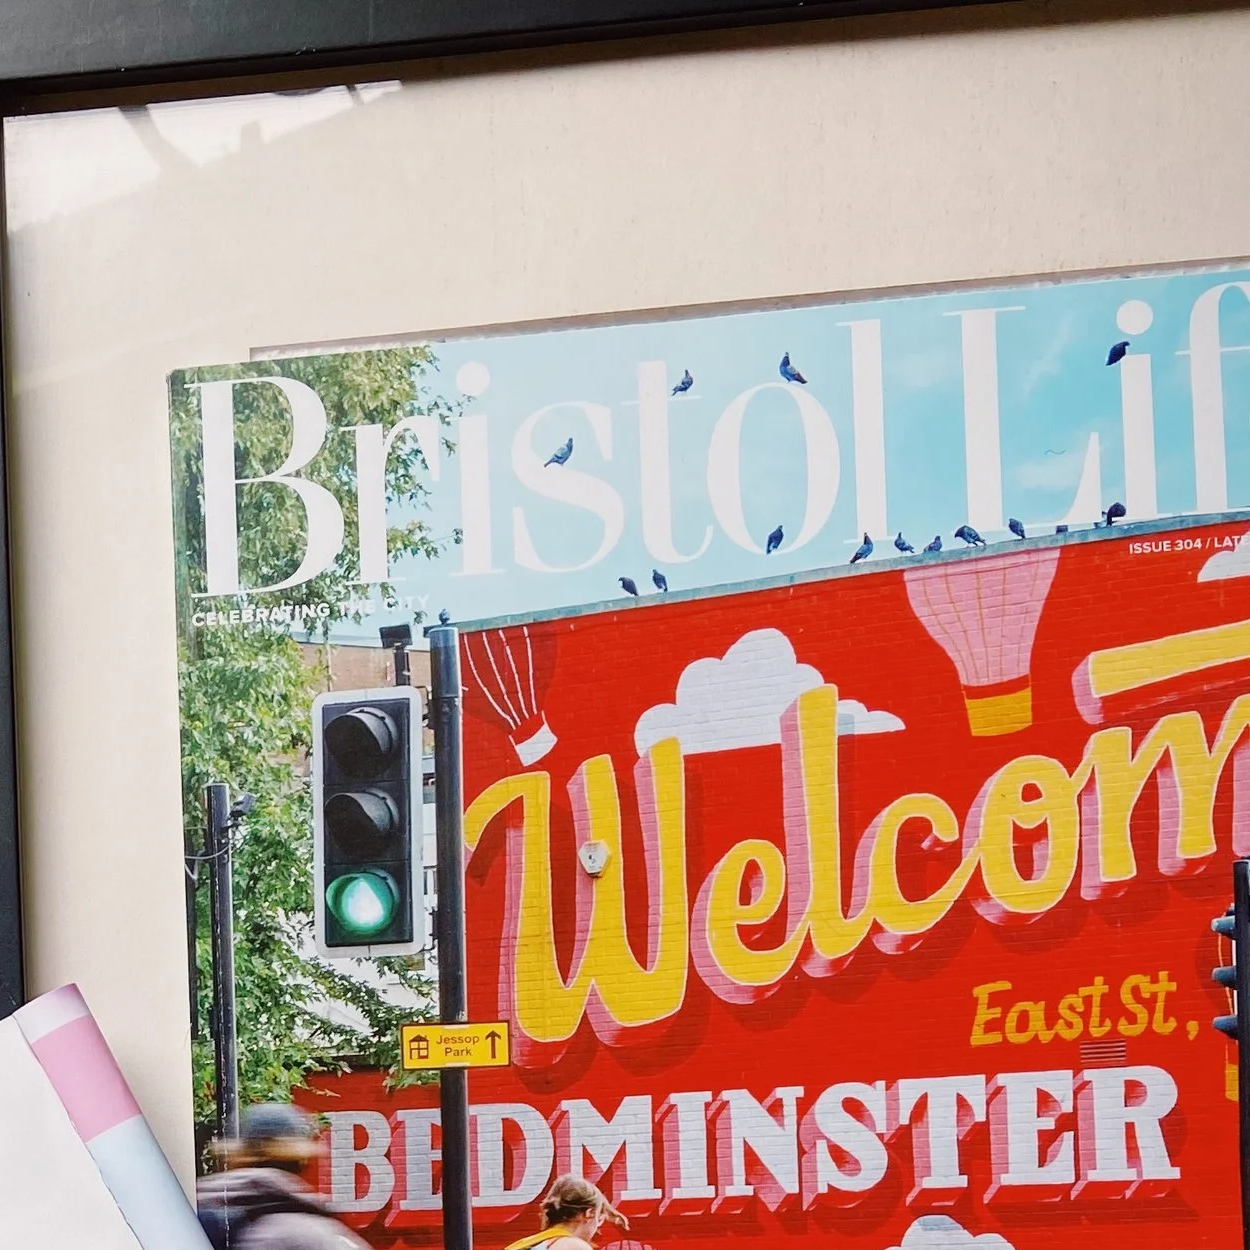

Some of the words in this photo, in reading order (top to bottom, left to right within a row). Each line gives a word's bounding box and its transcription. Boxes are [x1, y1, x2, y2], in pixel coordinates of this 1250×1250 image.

[184, 318, 895, 598] Bristol
[1129, 541, 1171, 554] ISSUE
[1174, 538, 1202, 550] 304
[191, 602, 331, 627] CELEBRATING
[970, 975, 1112, 1047] East
[436, 1034, 480, 1046] Jessop
[444, 1047, 473, 1057] Park
[323, 1065, 1181, 1214] BEDMINSTER
